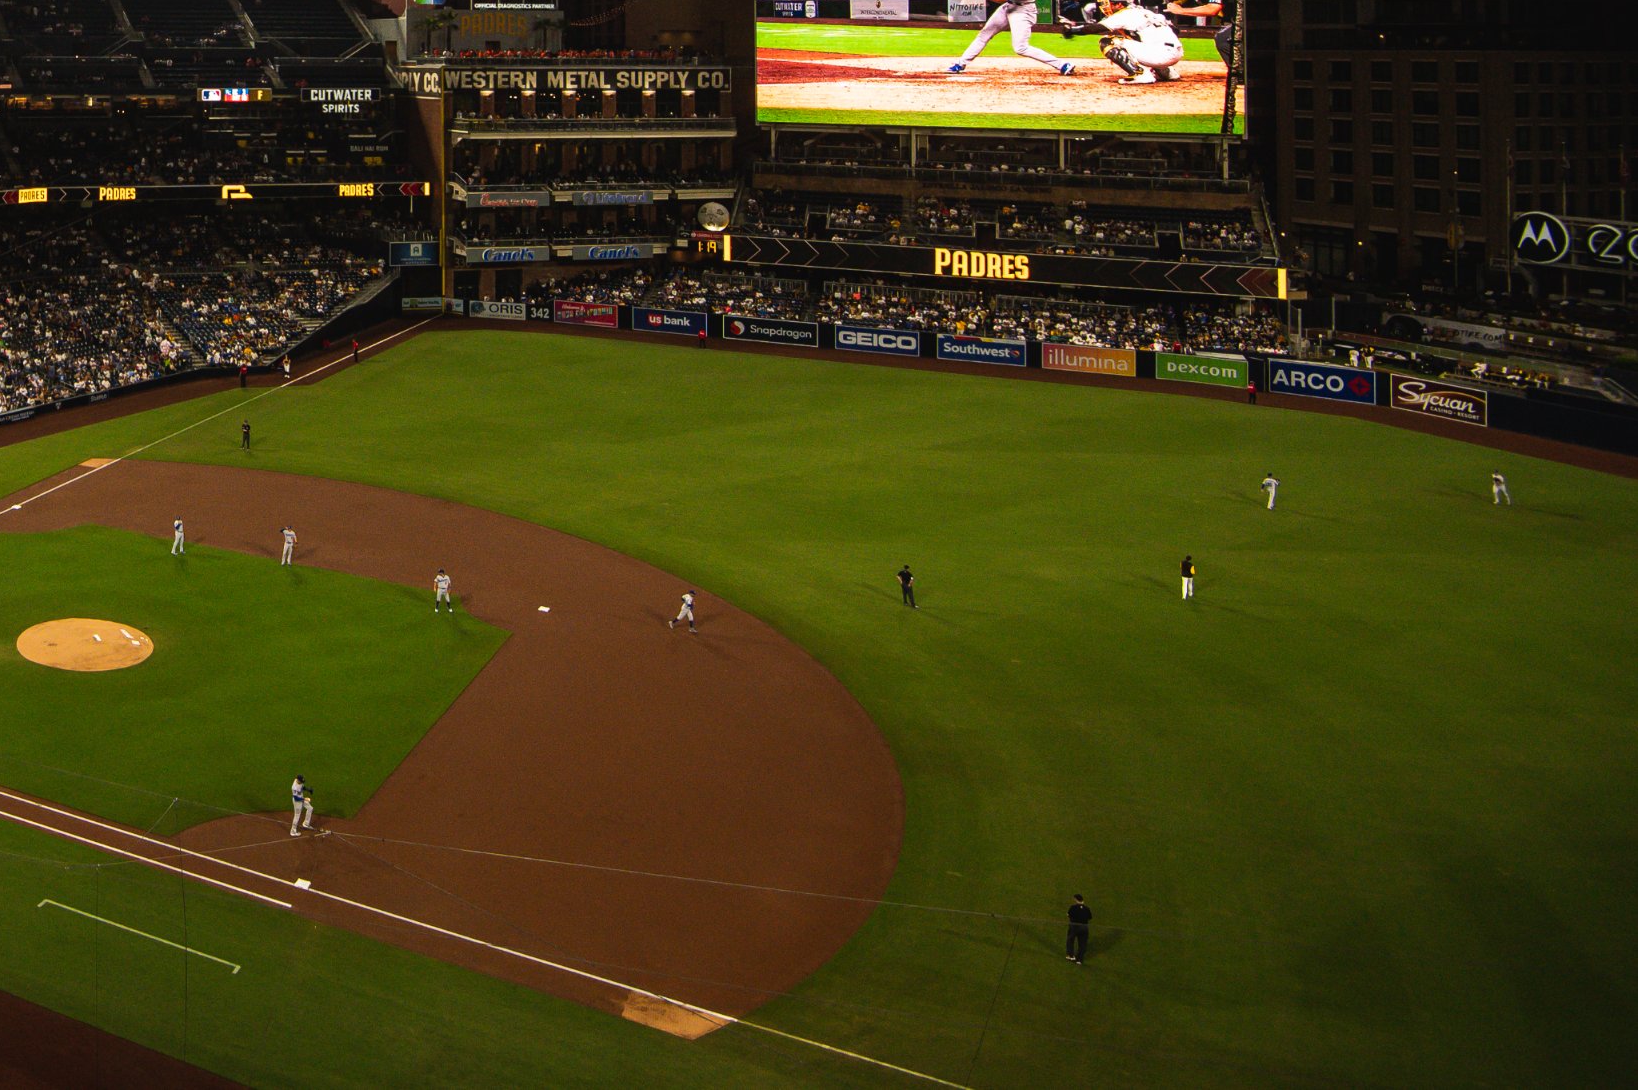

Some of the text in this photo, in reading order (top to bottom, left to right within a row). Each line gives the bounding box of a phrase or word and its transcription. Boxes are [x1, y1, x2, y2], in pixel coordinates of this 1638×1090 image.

[461, 13, 528, 38] PADRES
[444, 70, 730, 89] WESTERN METAL SUPPLY CO.
[310, 89, 373, 101] CUTWATER
[322, 103, 360, 113] SPIRITS
[20, 190, 46, 202] PADRES
[99, 187, 137, 201] PADRES
[339, 183, 374, 197] PADRES
[482, 248, 535, 262] Canel's
[588, 246, 640, 260] Canel's
[934, 247, 1030, 280] PADRES
[489, 303, 524, 315] ORIS
[530, 307, 550, 319] 342
[648, 314, 691, 327] us bank
[750, 323, 812, 340] Snapdragon
[838, 330, 917, 350] GEICO
[943, 342, 1011, 358] Southwest
[1048, 348, 1129, 372] illumina
[1272, 369, 1344, 393] ARCO
[1398, 380, 1476, 410] Sycuan
[1429, 406, 1452, 415] CASINO
